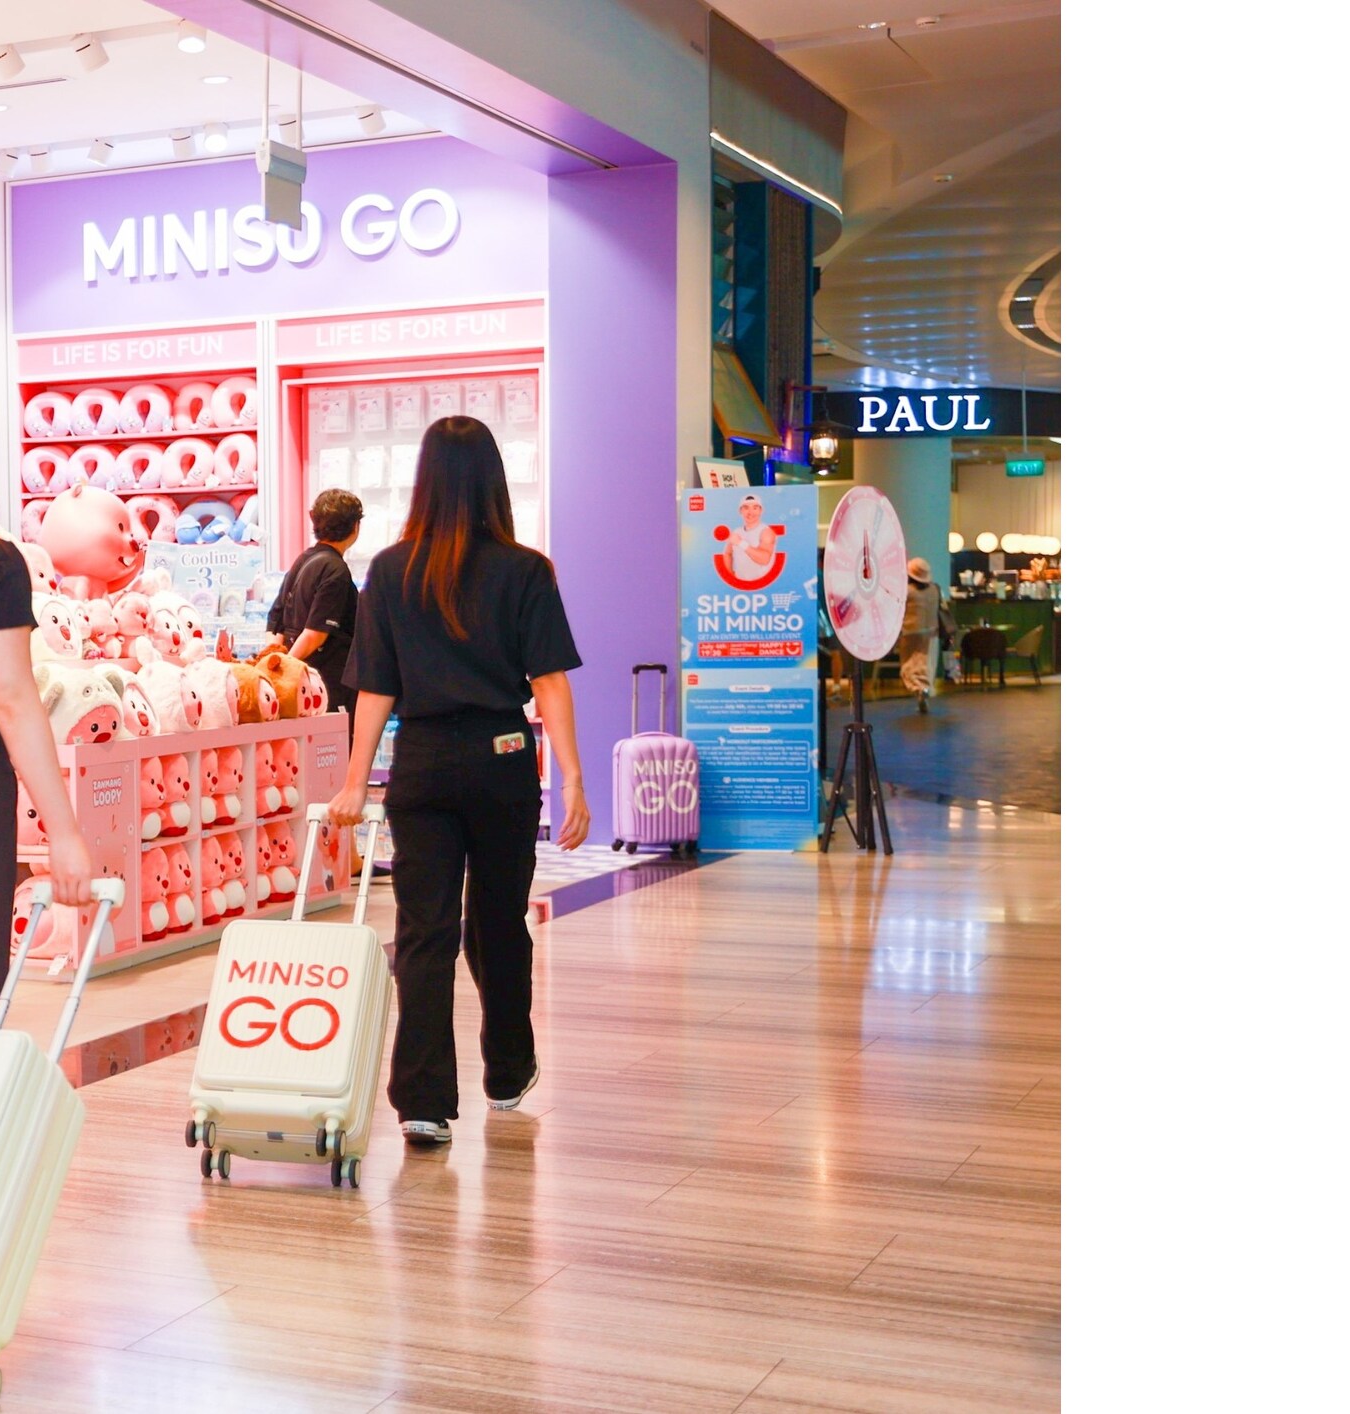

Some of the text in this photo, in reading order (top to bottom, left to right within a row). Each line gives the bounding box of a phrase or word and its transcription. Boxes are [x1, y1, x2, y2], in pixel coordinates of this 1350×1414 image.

[83, 187, 460, 282] MINISO GO
[315, 312, 507, 347] LIFE IS FOR FUN
[52, 335, 223, 366] LIFE IS FOR FUN
[857, 395, 991, 433] PAUL
[181, 551, 238, 566] Cooling
[697, 594, 768, 614] SHOP
[697, 614, 804, 632] IN MINISO
[633, 759, 698, 776] MINISO
[92, 777, 122, 791] ZANMANG
[92, 788, 122, 808] LOOPY
[634, 780, 698, 815] GO
[228, 959, 349, 990] MINISO
[218, 995, 340, 1051] GO
